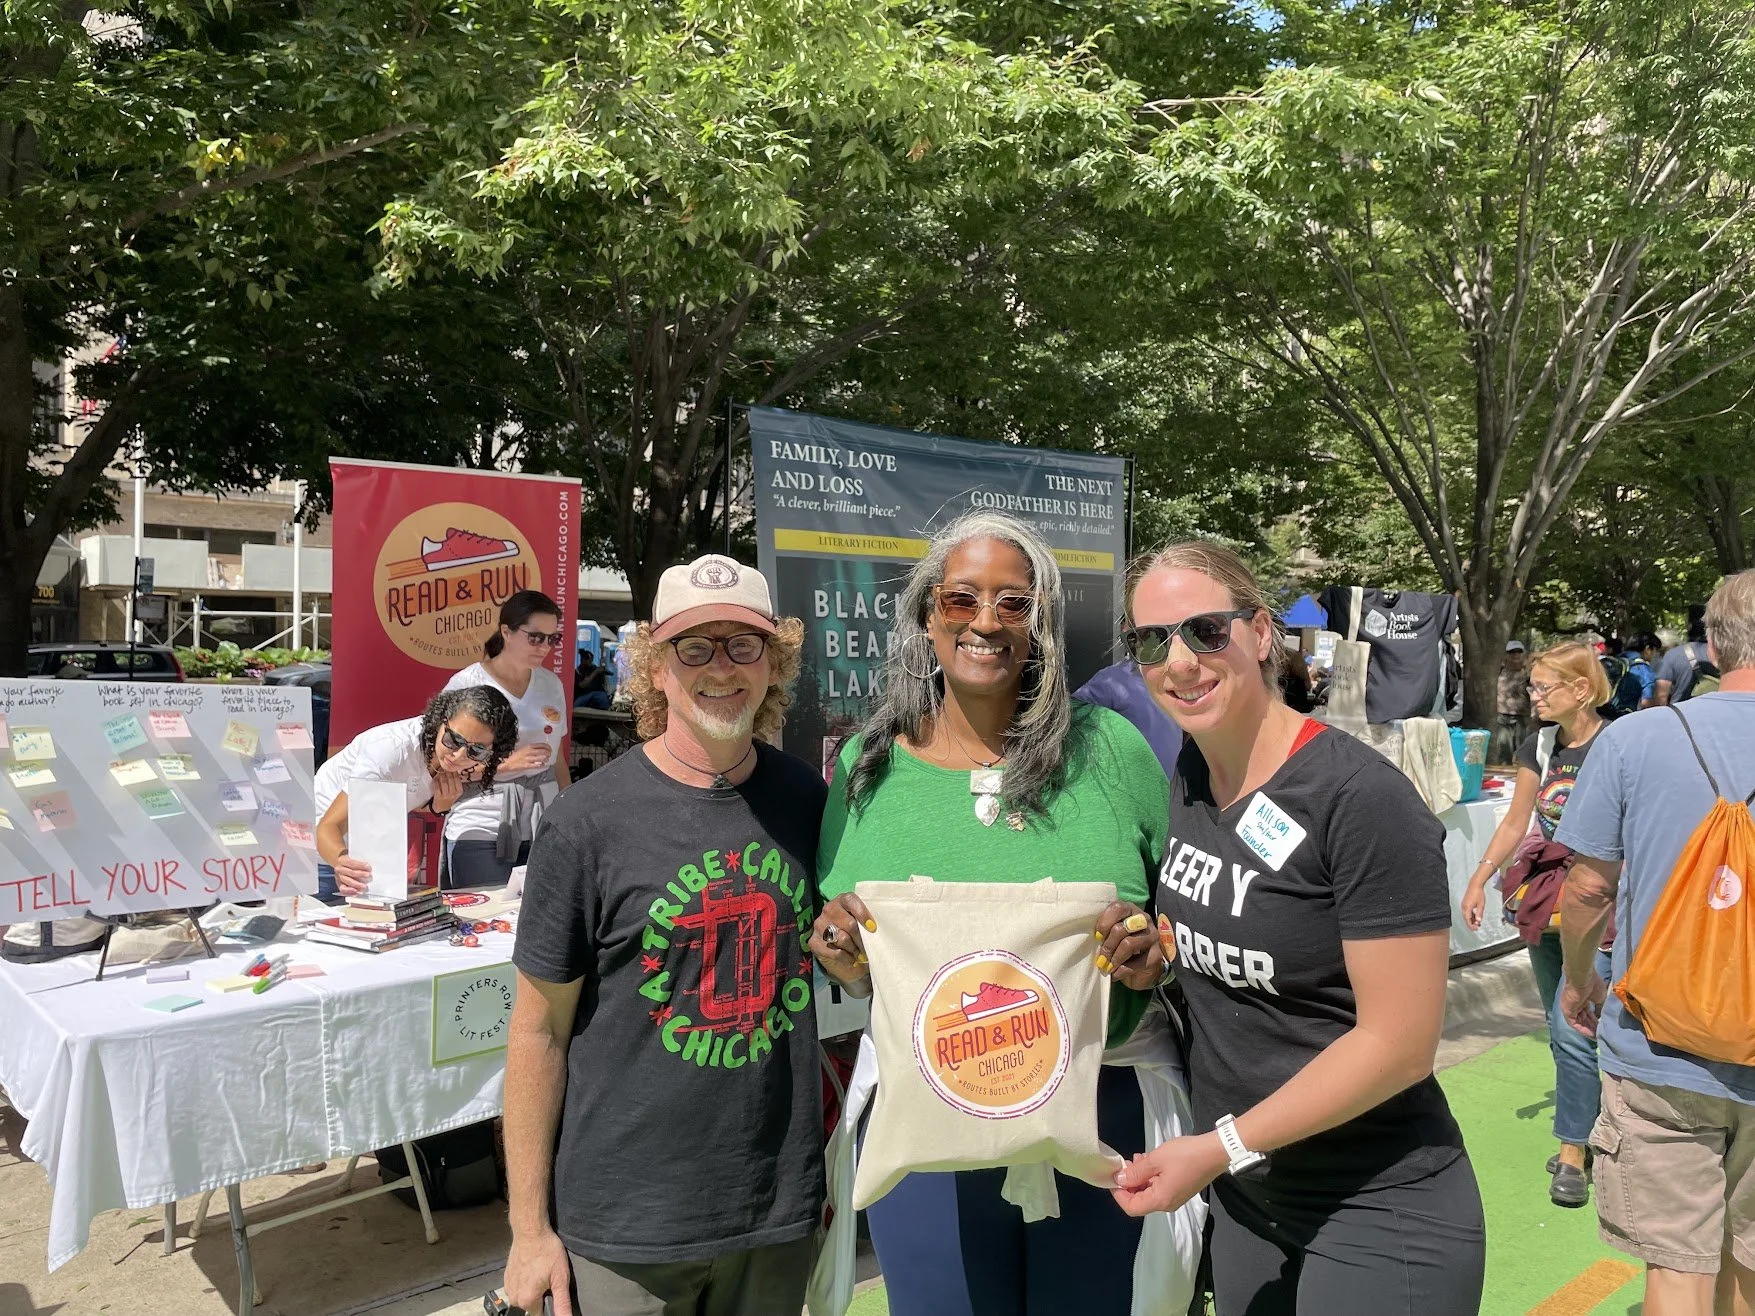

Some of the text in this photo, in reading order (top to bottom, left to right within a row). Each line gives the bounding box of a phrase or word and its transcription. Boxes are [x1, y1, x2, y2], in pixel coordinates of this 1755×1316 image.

[770, 440, 897, 472] FAMILY, LOVE
[771, 470, 863, 496] AND LOSS
[1045, 474, 1113, 496] THE NEXT
[788, 496, 821, 512] clever,
[823, 499, 867, 515] brilliant
[970, 490, 1114, 520] GODFATHER IS HERE
[819, 535, 899, 550] LITERARY FICTION
[1039, 520, 1058, 533] epic,
[1059, 521, 1080, 536] richly
[1071, 553, 1097, 564] FICTION
[388, 562, 527, 628] READ & RUN
[435, 607, 492, 635] CHICAGO
[1387, 629, 1418, 640] House
[413, 637, 443, 656] ROUTES
[445, 647, 470, 657] BUILT
[98, 685, 123, 696] What
[127, 685, 137, 696] is
[828, 669, 882, 698] LAK
[1241, 824, 1273, 858] Founder
[0, 852, 286, 913] TELL YOUR STORY
[1160, 836, 1261, 918] LEER Y
[643, 849, 726, 950] TRIBE
[1157, 908, 1280, 996] RRER
[454, 978, 512, 1022] PRINTERS ROW
[638, 970, 672, 1003] A
[460, 1018, 505, 1041] LIT FEST
[661, 977, 810, 1069] CHICAGO
[937, 1007, 1049, 1071] READ & RUN
[978, 1050, 1025, 1077] CHICAGO
[962, 1063, 1043, 1096] ROUTES BUILT BY STORIES
